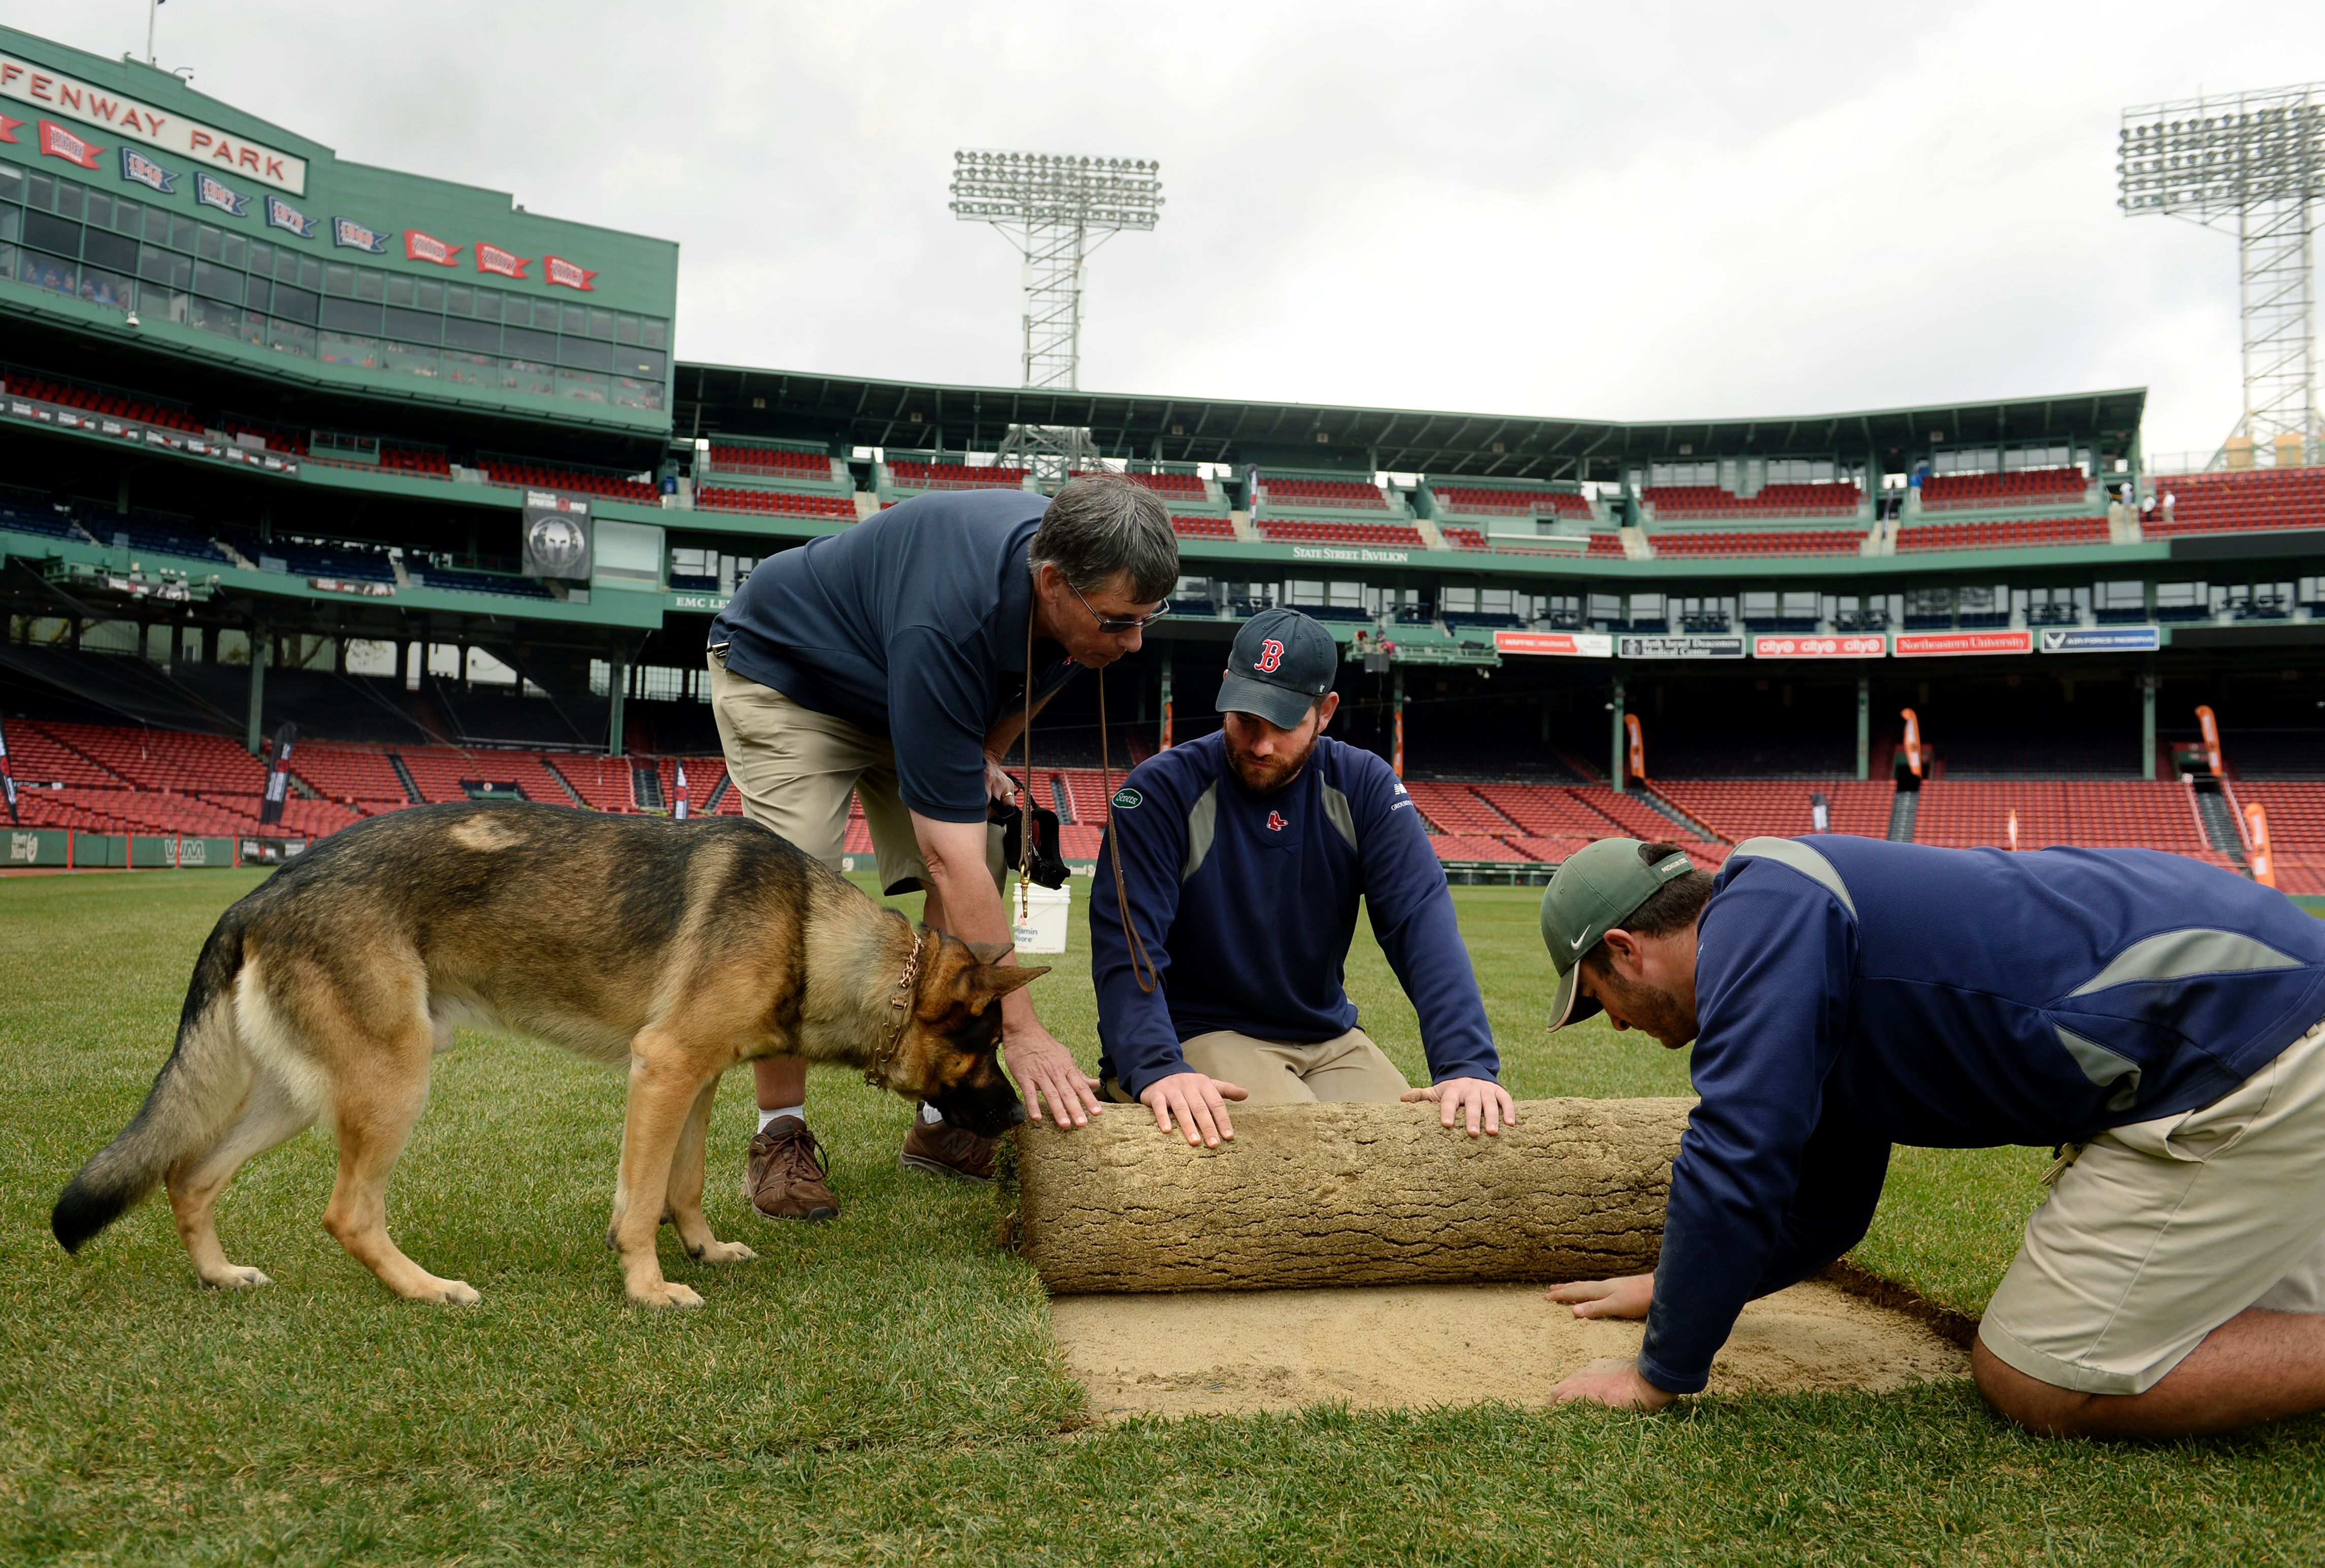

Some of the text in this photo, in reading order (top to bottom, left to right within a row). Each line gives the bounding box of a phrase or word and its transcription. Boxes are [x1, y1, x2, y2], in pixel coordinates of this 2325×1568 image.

[1, 62, 284, 180] FENWAY PARK
[51, 131, 83, 157] 1918
[481, 250, 517, 271] 2007
[1293, 546, 1408, 562] STATE STREET PAVILION
[676, 597, 706, 608] EMC
[1901, 636, 2026, 651] Northeastern University
[1254, 638, 1285, 673] B
[1116, 792, 1138, 805] Scotts
[11, 844, 26, 859] Nine
[164, 839, 205, 859] WM
